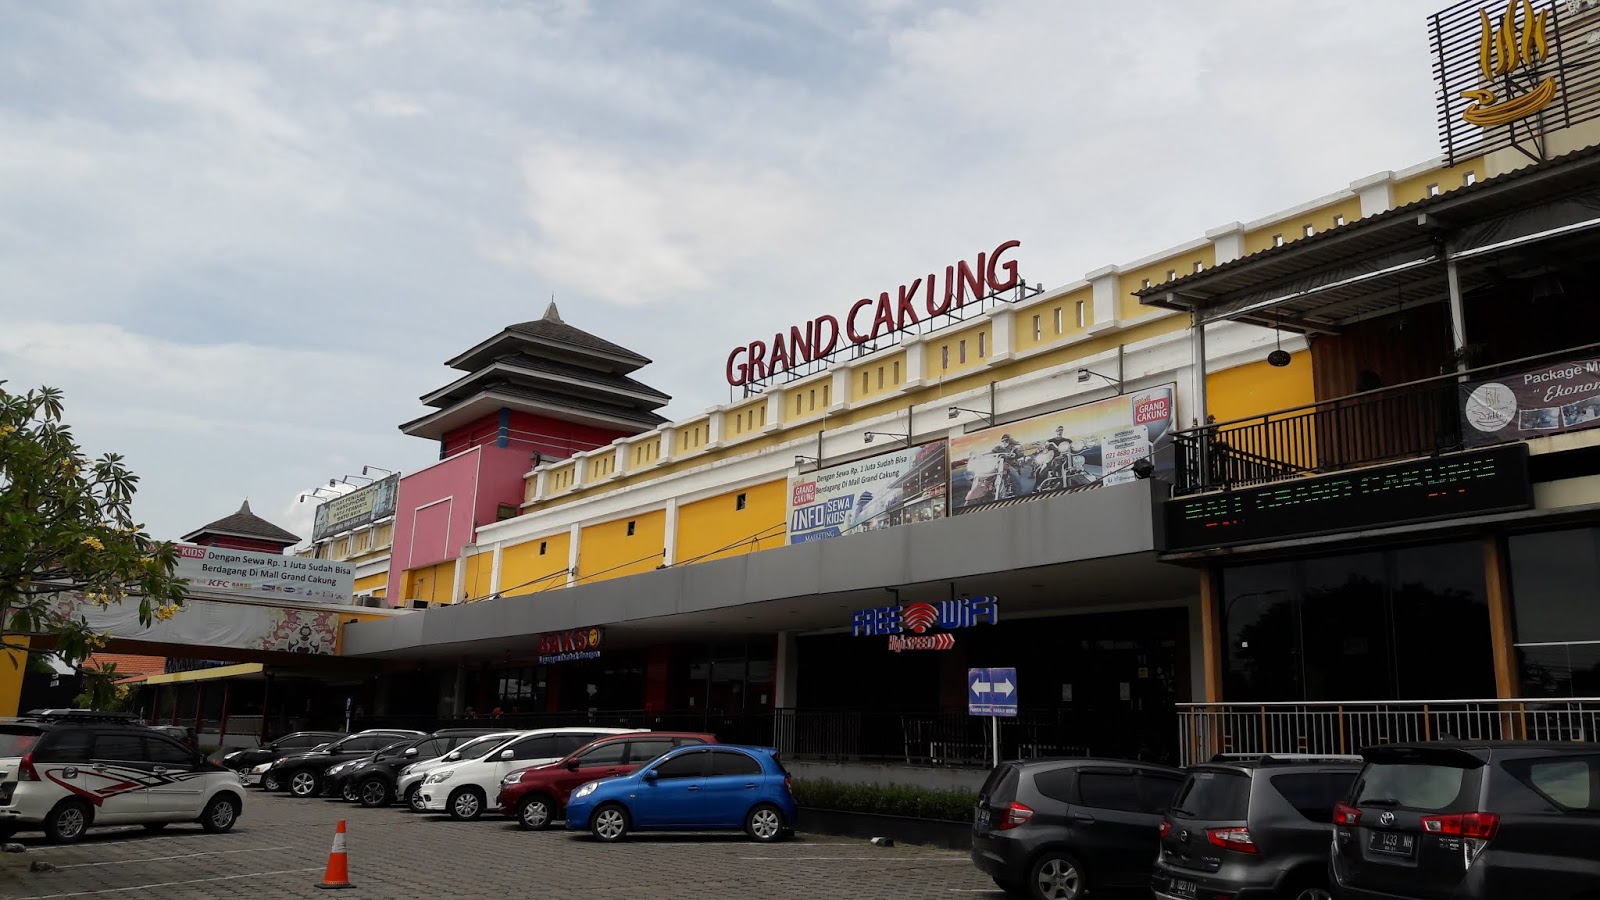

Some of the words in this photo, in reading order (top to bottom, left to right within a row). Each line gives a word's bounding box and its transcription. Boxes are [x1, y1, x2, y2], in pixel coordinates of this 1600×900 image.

[726, 315, 839, 386] GRAND
[846, 240, 1021, 344] CAKUNG
[1524, 366, 1582, 385] Package
[1586, 361, 1600, 373] M
[1139, 401, 1165, 413] GRAND
[1137, 409, 1168, 422] CAKUNG
[1105, 451, 1115, 459] 021
[817, 473, 835, 483] Dengan
[836, 470, 850, 479] Sewa
[850, 467, 859, 476] Rp.
[865, 463, 876, 472] Juta
[877, 458, 894, 469] Sudah
[895, 456, 908, 464] Bisa
[795, 484, 814, 496] GRAND
[815, 483, 841, 495] Berdagang
[848, 477, 860, 486] Mall
[861, 474, 878, 484] Grand
[878, 470, 900, 481] Cakung
[793, 492, 815, 504] CAKUNG
[827, 497, 850, 512] SEWA
[793, 504, 825, 531] INFO
[826, 511, 846, 525] KIDS
[805, 530, 835, 542] MARKETING
[181, 547, 205, 558] KIDS
[208, 551, 241, 563] Dengan
[242, 556, 265, 566] Sewa
[267, 558, 280, 567] Rp.
[283, 560, 287, 568] 1
[290, 561, 306, 570] Juta
[308, 563, 333, 573] Sudah
[335, 566, 351, 575] Bisa
[202, 563, 247, 577] Berdagang
[249, 568, 258, 577] Di
[260, 570, 279, 579] Mall
[281, 573, 306, 582] Grand
[307, 575, 337, 587] Cakung
[208, 579, 230, 588] KFC
[851, 605, 904, 638] FREE
[905, 635, 937, 651] SPEED
[1370, 832, 1376, 843] F
[1382, 834, 1398, 846] 1433
[1403, 836, 1413, 847] NH
